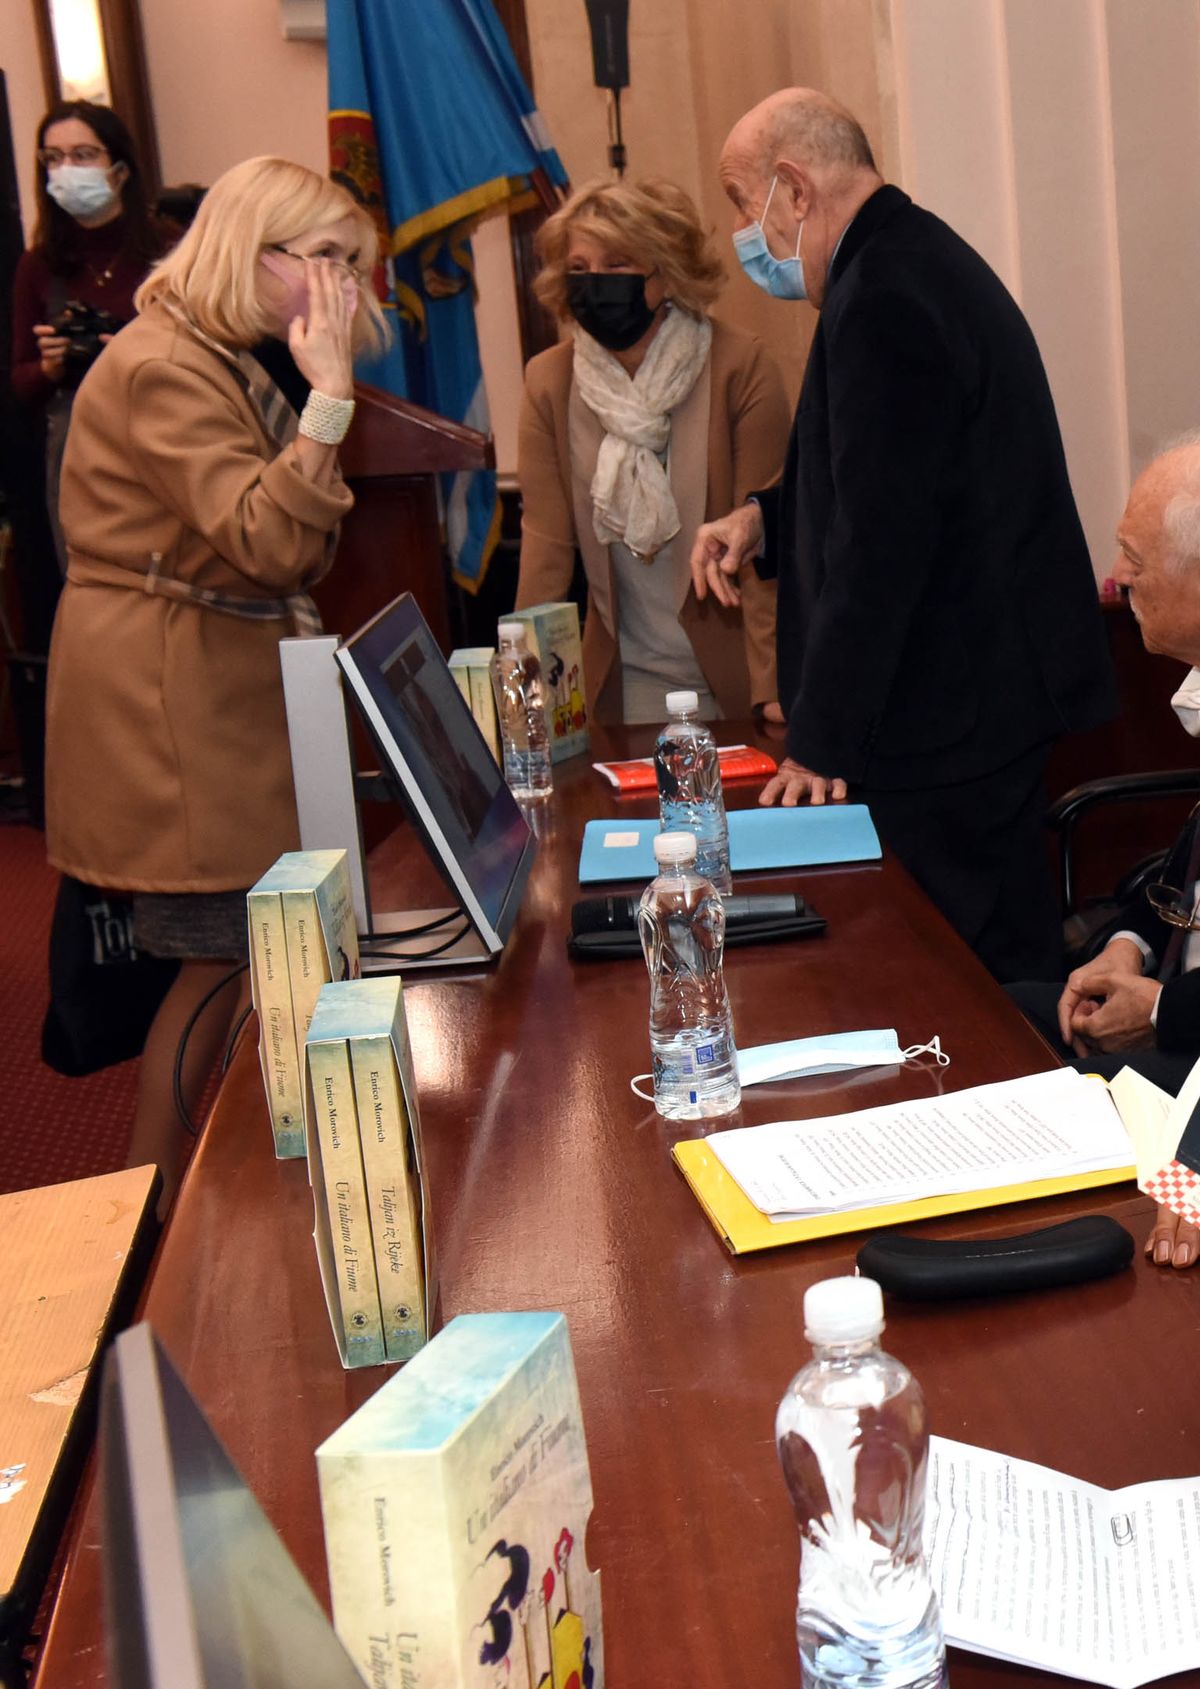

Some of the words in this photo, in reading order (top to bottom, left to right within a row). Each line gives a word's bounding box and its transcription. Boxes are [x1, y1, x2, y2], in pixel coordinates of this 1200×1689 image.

[262, 922, 271, 945] Enrico
[298, 919, 307, 942] Enrico
[300, 944, 309, 978] Morovich
[324, 1077, 336, 1107] Enrico
[370, 1071, 381, 1101] Enrico
[328, 1108, 340, 1150] Morovich
[373, 1103, 385, 1143] Morovich
[335, 1181, 348, 1200] Un
[338, 1202, 352, 1244] italiano
[381, 1186, 395, 1225] Talijan
[388, 1240, 400, 1275] Rijeke
[344, 1245, 357, 1256] di
[345, 1259, 358, 1293] Fiume
